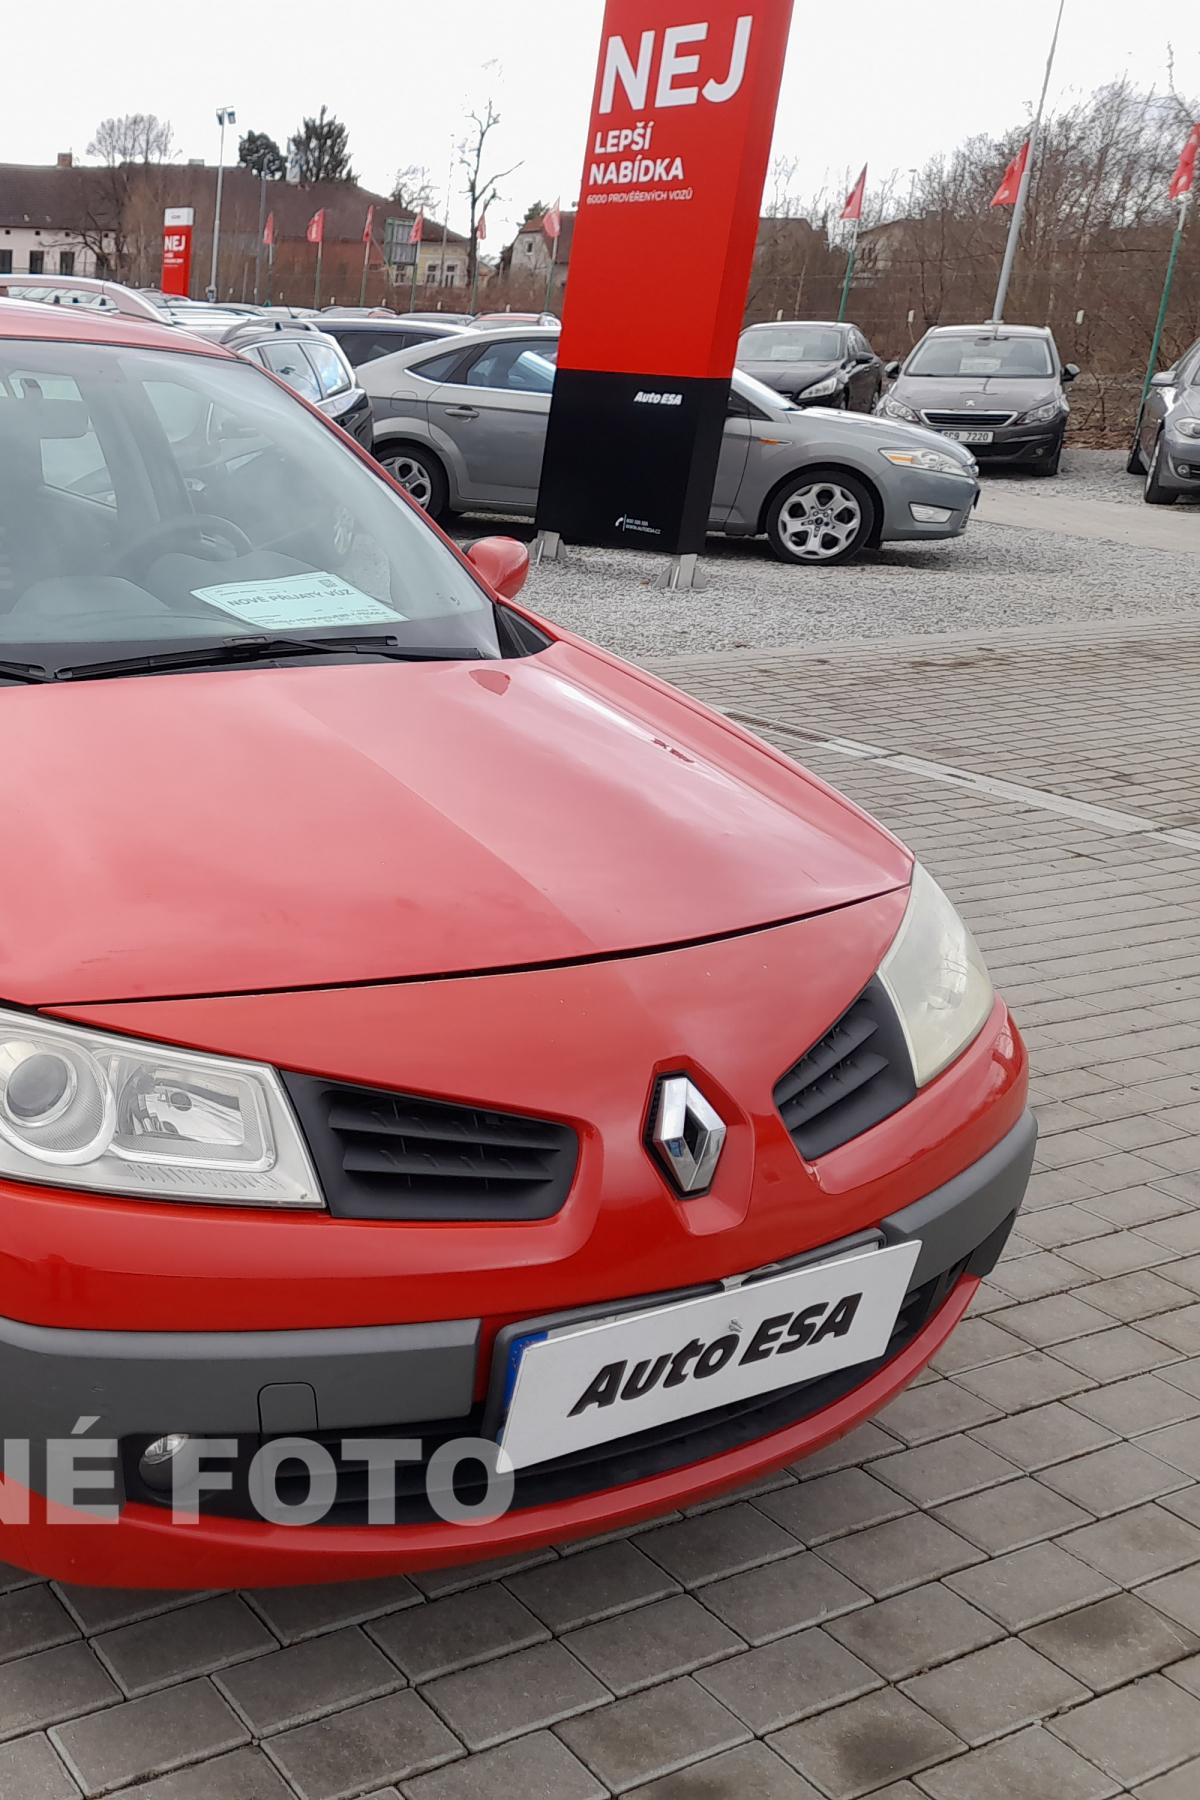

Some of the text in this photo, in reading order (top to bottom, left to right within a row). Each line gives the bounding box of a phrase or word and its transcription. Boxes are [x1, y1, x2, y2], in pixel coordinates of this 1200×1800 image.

[598, 15, 753, 115] NEJ
[594, 121, 655, 154] LEPŠÍ
[588, 155, 685, 186] NABÍDKA
[164, 235, 186, 252] NEJ
[633, 391, 682, 405] Auto ESA
[966, 432, 989, 441] 7220
[566, 1291, 863, 1419] Auto ESA
